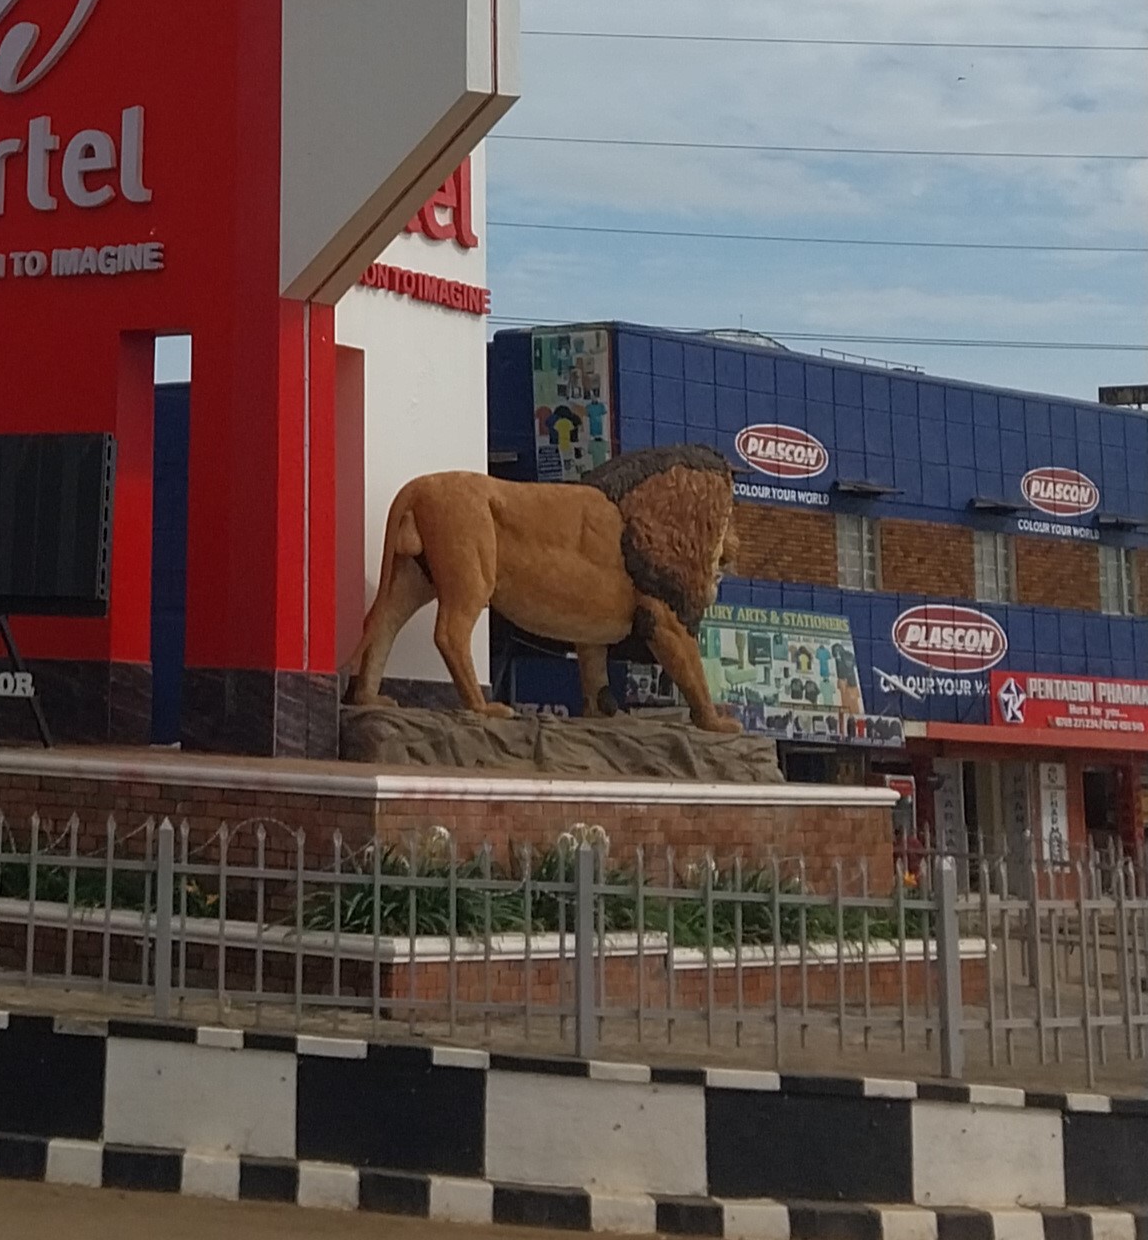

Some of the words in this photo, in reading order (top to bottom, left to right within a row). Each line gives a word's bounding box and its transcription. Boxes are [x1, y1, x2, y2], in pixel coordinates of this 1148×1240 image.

[405, 155, 479, 248] el
[10, 250, 47, 277] TO
[51, 242, 164, 277] IMAGINE
[392, 266, 417, 295] TO
[416, 272, 492, 315] IMAGINE
[746, 436, 819, 466] PLASCON
[732, 482, 771, 499] COLOUR
[771, 487, 797, 502] YOUR
[797, 490, 830, 506] WORLD
[1030, 479, 1091, 503] PLASCON
[1017, 519, 1050, 534] COLOUR
[1051, 523, 1072, 537] YOUR
[1072, 526, 1100, 540] WORLD
[737, 607, 767, 623] ARTS
[770, 610, 780, 623] &
[782, 612, 850, 632] STATIONERS
[904, 624, 995, 653] PLASCON
[936, 677, 972, 696] YOUR
[1027, 677, 1094, 702] PENTAGON
